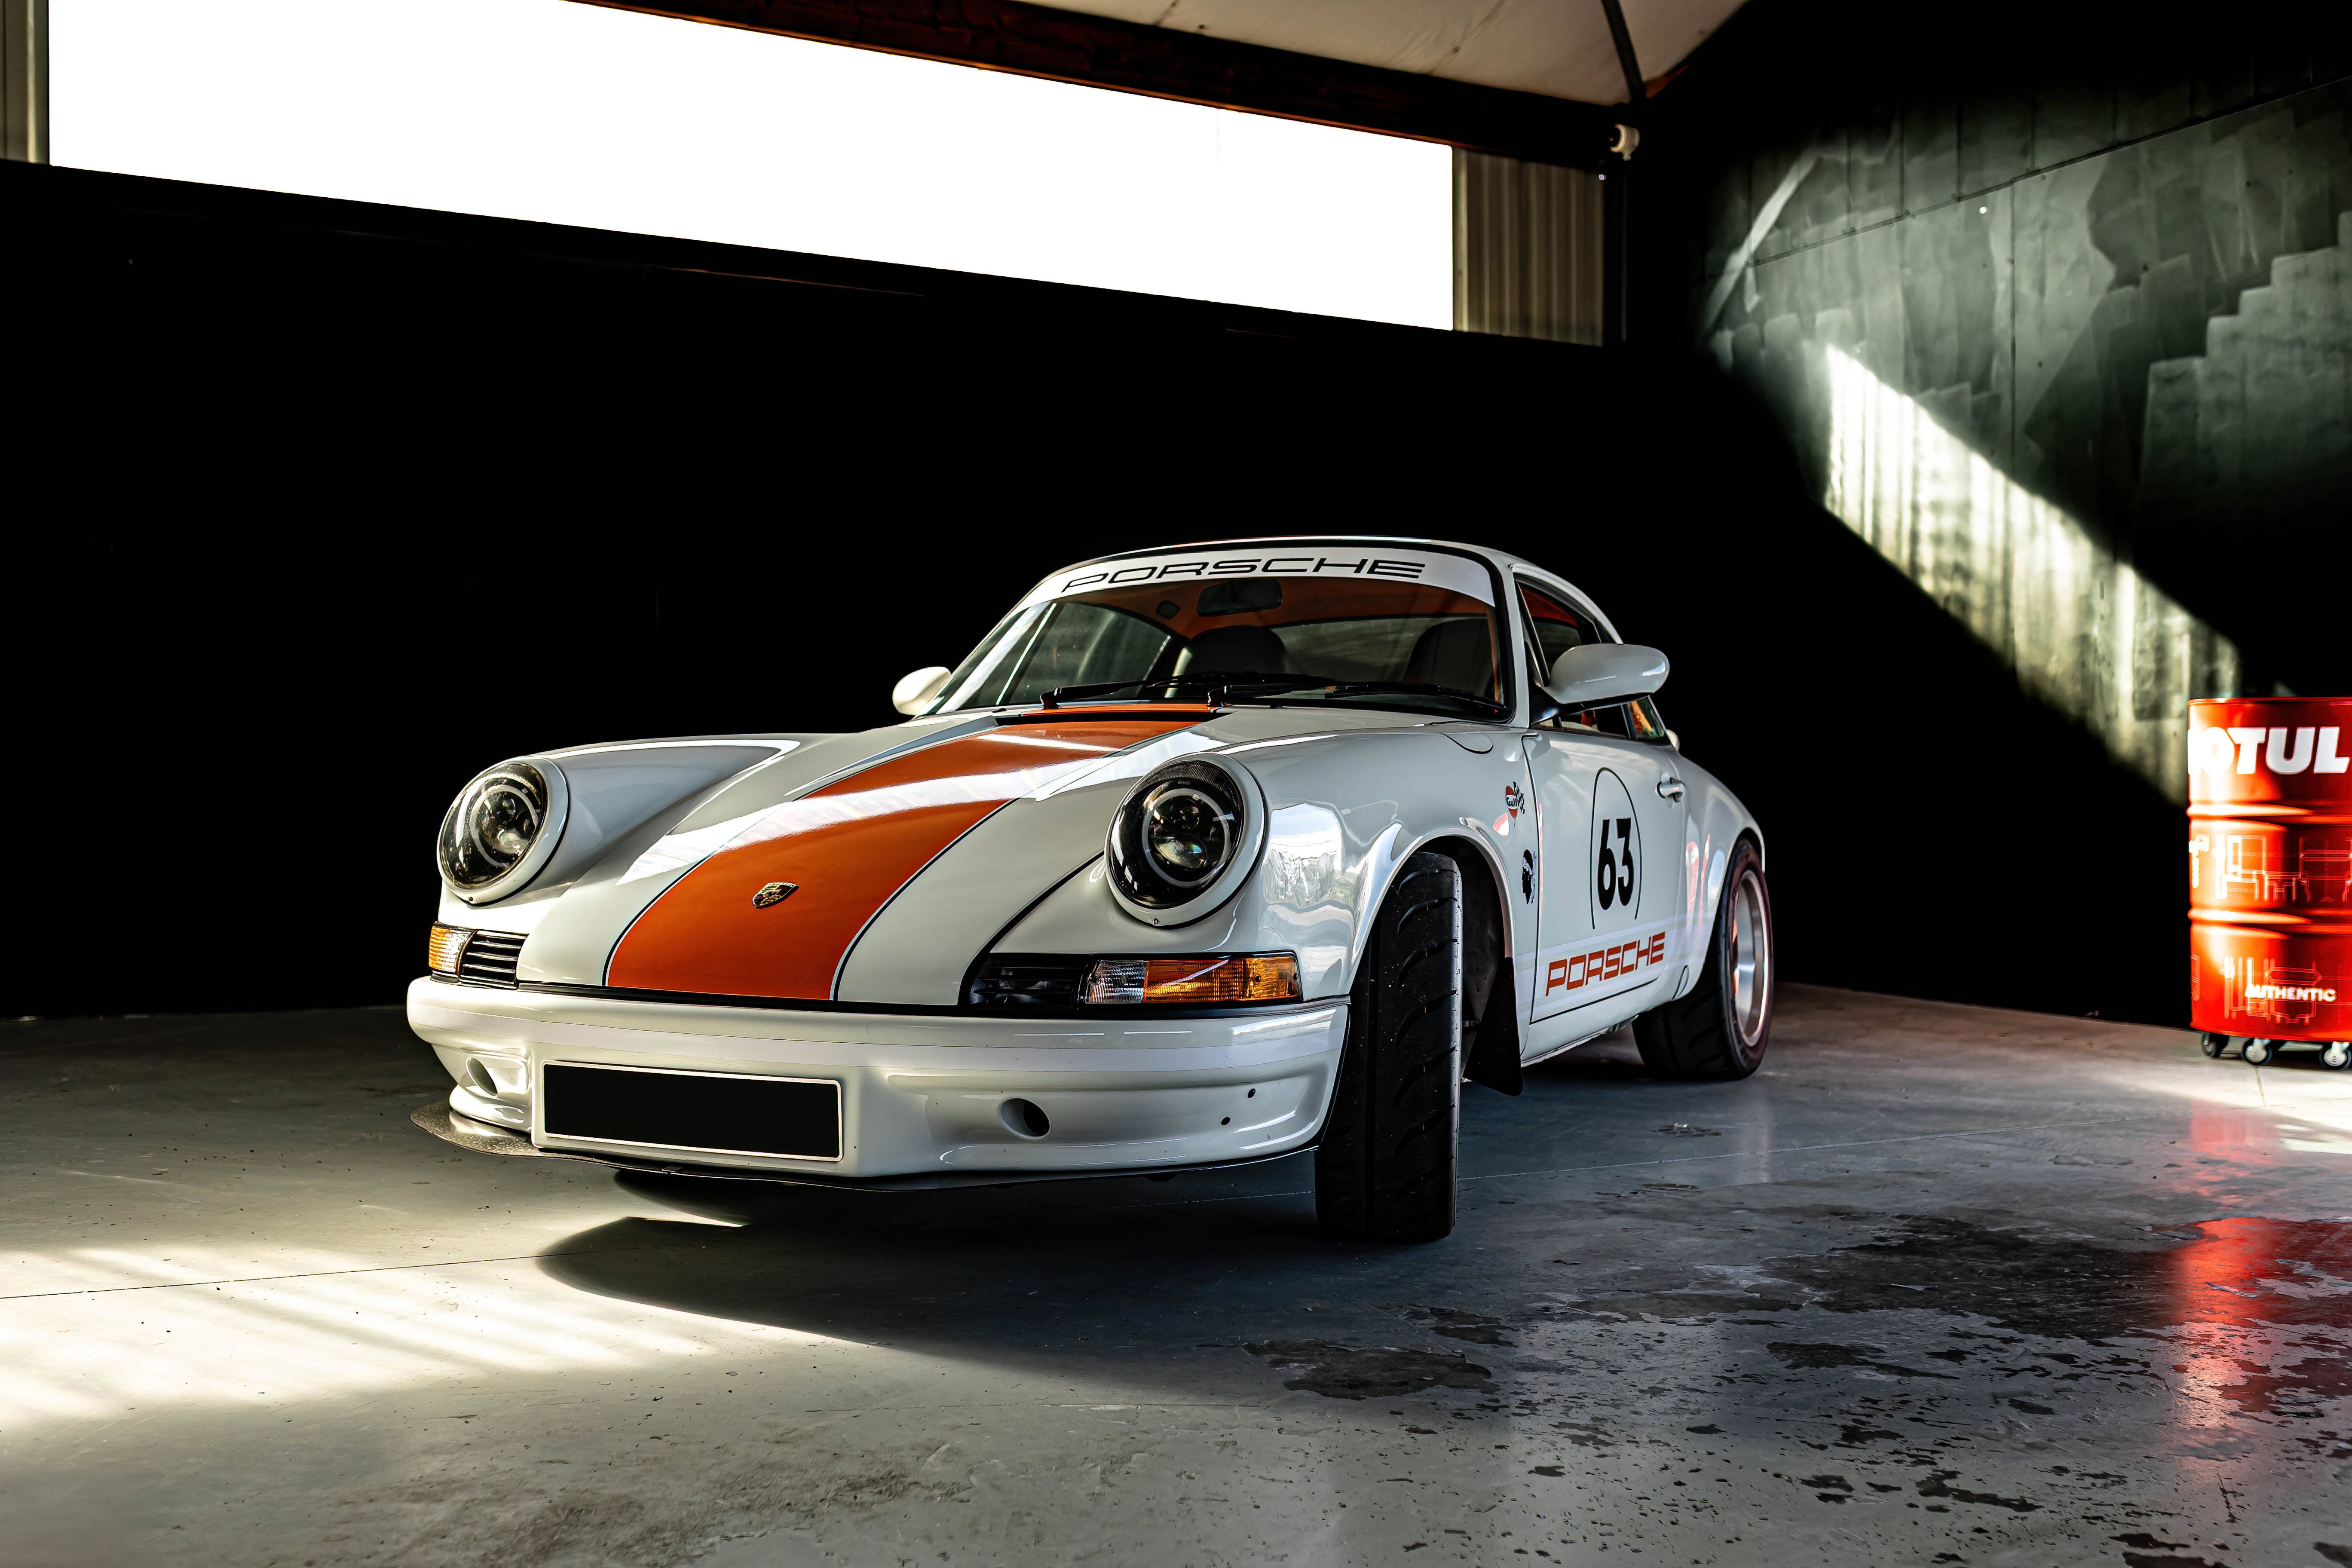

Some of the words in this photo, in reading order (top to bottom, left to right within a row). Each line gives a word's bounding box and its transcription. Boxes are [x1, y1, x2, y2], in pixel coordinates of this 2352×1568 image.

[1061, 557, 1426, 593] PORSCHE
[1506, 796, 1520, 807] Gulf
[1597, 818, 1634, 910] 63
[1545, 931, 1666, 997] PORSCHE
[2245, 983, 2337, 1002] AUTHENTIC
